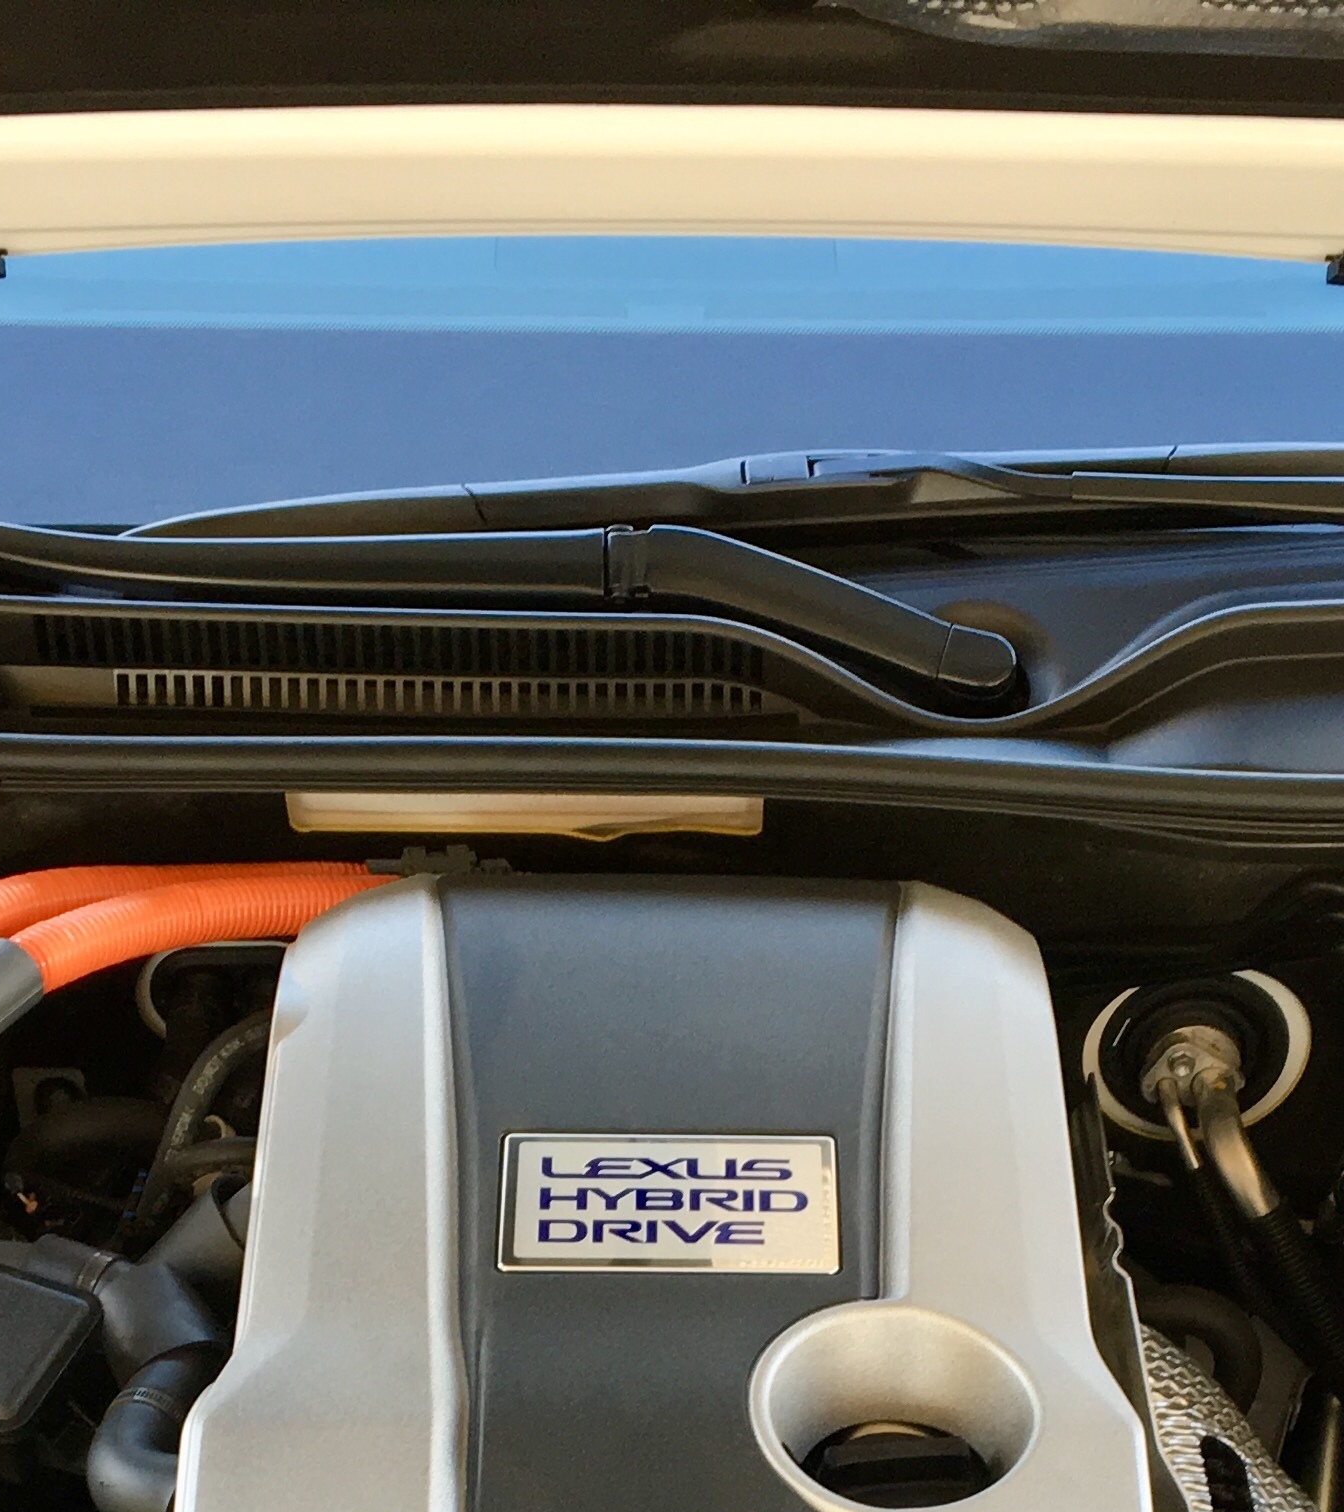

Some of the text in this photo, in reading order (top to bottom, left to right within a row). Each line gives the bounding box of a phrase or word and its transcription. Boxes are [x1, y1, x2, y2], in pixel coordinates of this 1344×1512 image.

[541, 1156, 794, 1181] LEXUS
[538, 1187, 809, 1213] HYBRID
[537, 1219, 766, 1245] DRIVE
